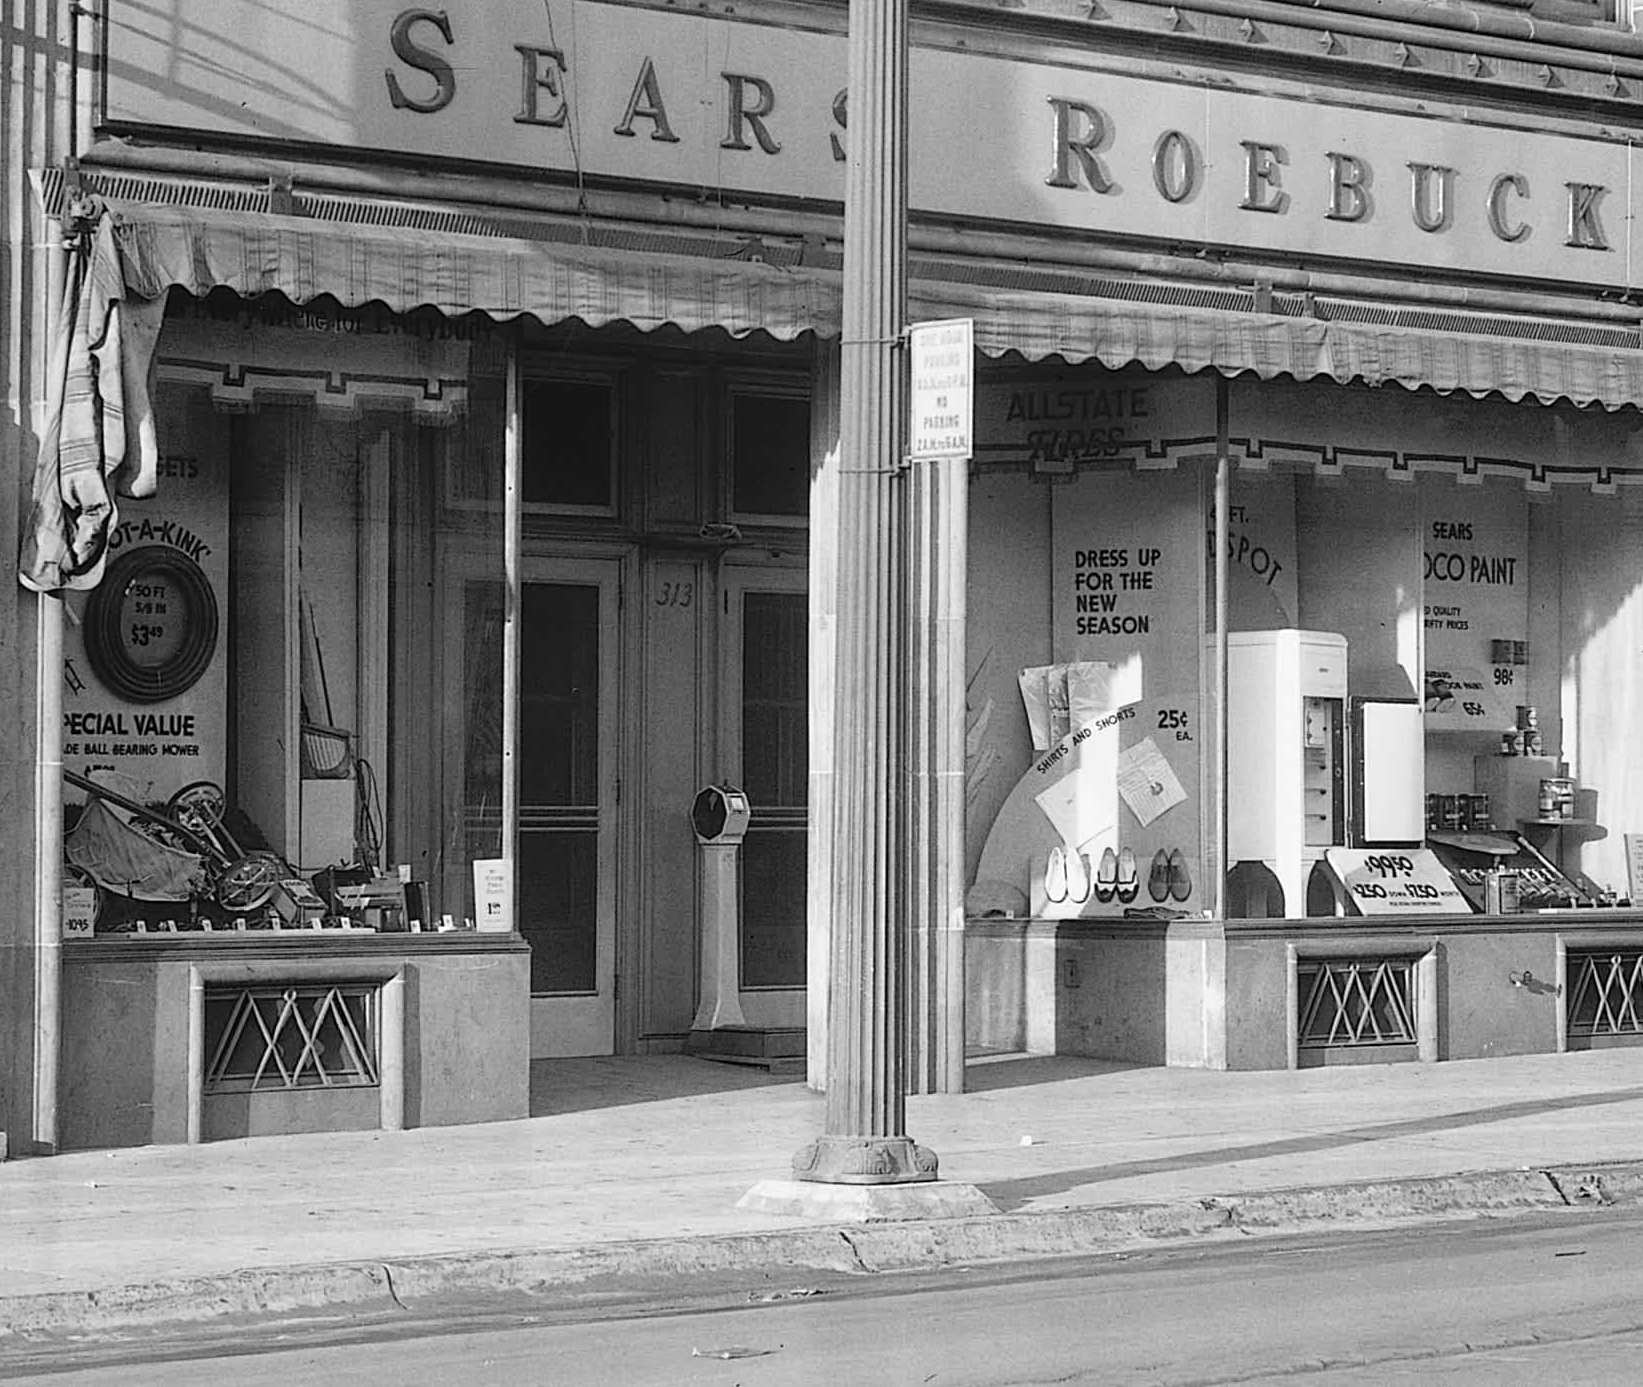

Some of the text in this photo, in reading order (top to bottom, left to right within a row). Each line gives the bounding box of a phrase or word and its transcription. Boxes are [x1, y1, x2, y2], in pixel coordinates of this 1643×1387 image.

[1044, 94, 1614, 251] ROEBUCK
[1007, 387, 1148, 423] ALLSTATE
[1432, 521, 1473, 541] SEARS
[1075, 548, 1162, 569] DRESS UP
[1471, 555, 1517, 585] PAINT
[134, 584, 152, 598] 50
[1075, 570, 1154, 592] FOR THE
[655, 580, 696, 609] 313
[1076, 594, 1117, 613] NEW
[1076, 615, 1149, 635] SEASON
[133, 714, 195, 737] VALUE
[1157, 709, 1189, 729] 25¢
[1036, 707, 1137, 774] SHIRTS AND SHORTS
[1175, 731, 1194, 741] EA.
[84, 743, 200, 757] BALL BEARING MOWER
